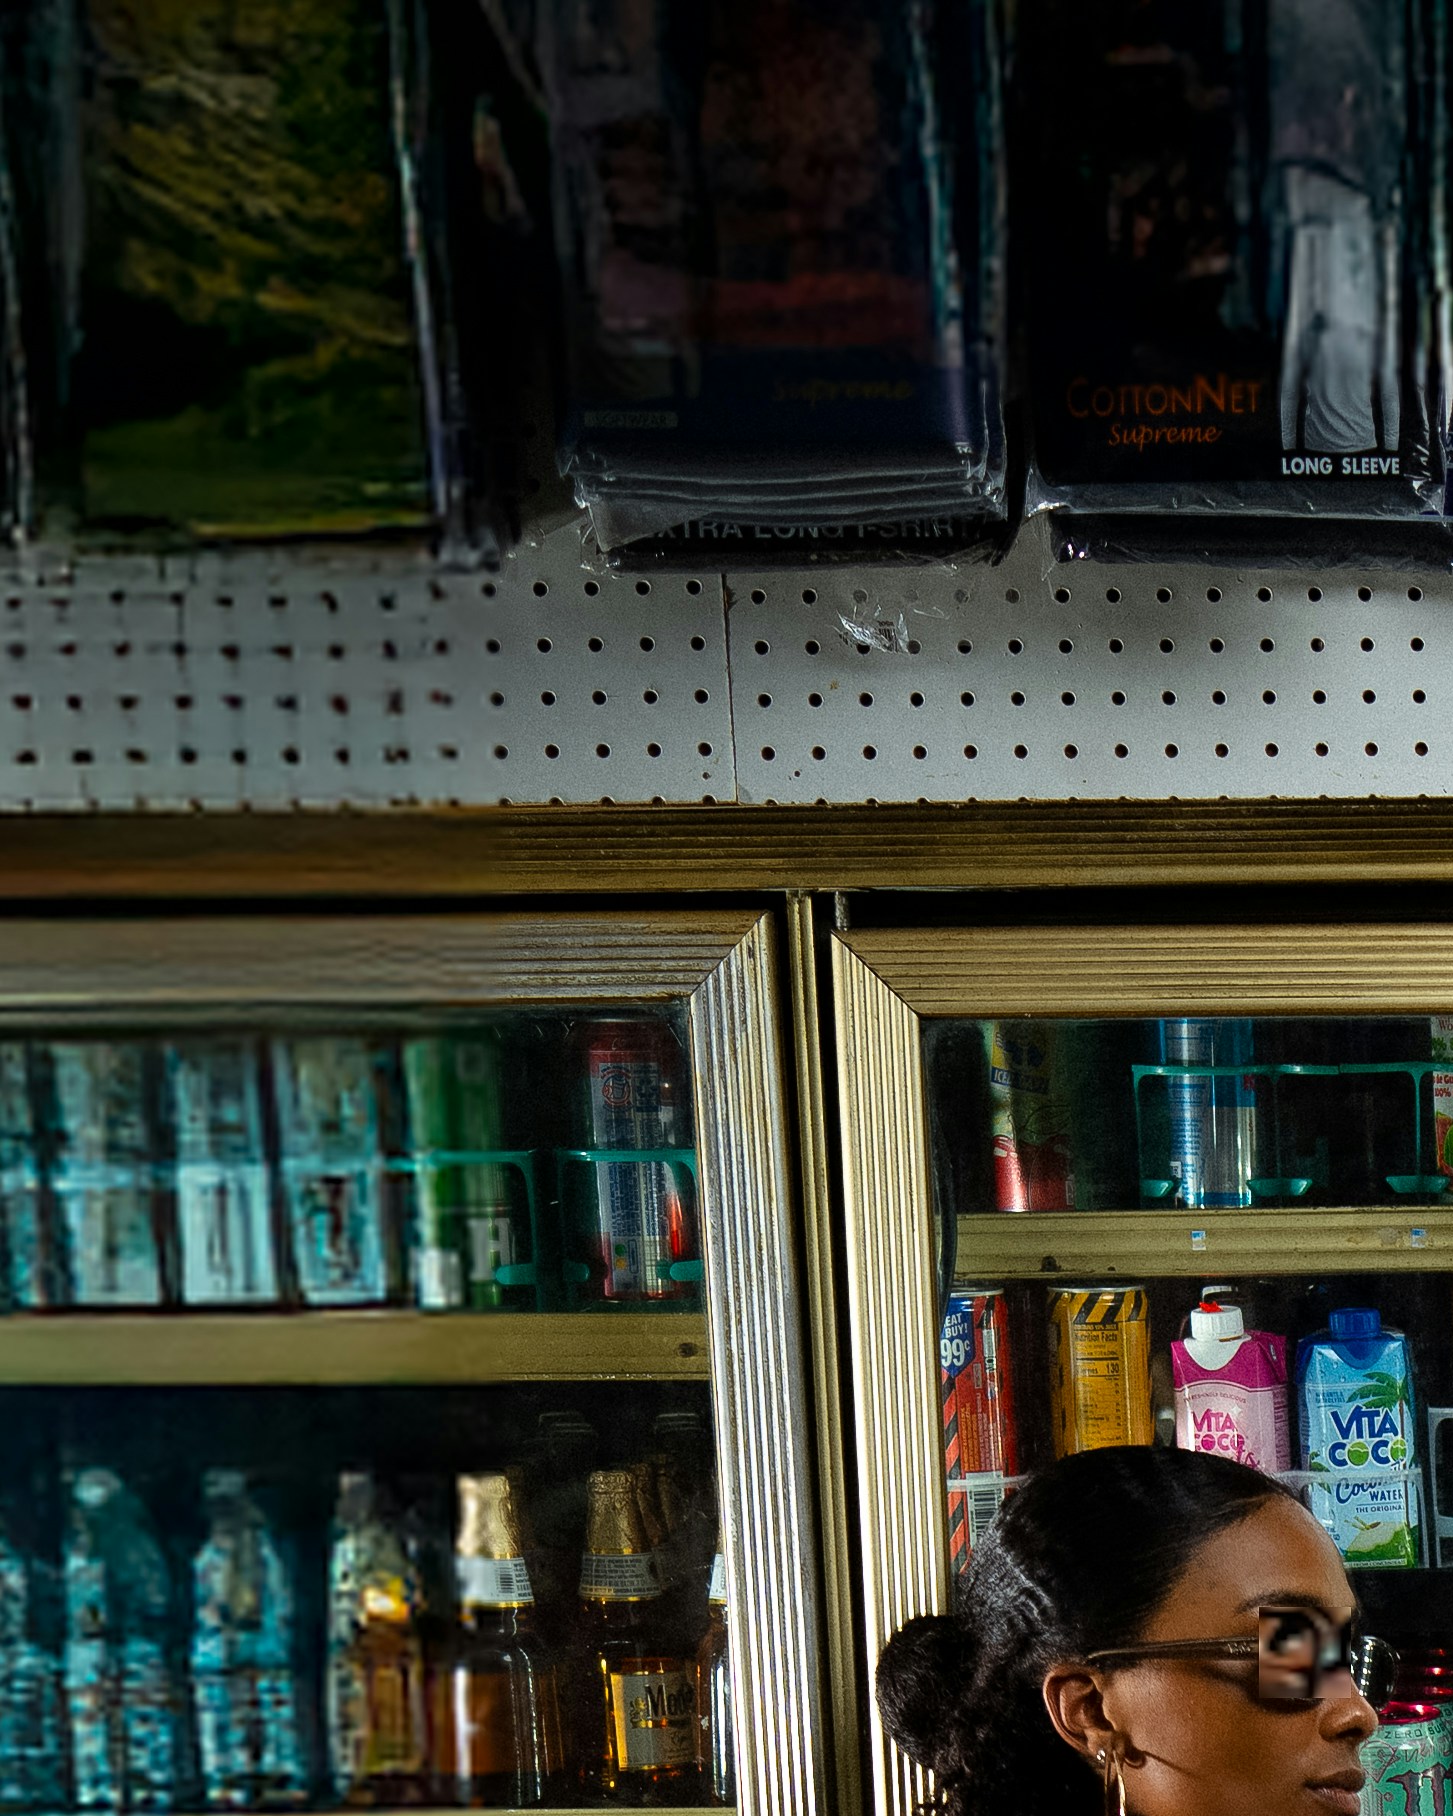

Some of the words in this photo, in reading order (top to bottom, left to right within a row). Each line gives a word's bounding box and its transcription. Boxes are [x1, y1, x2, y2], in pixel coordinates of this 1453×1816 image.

[1105, 422, 1224, 453] Supreme
[1281, 456, 1333, 476] LONG
[1342, 456, 1400, 476] SLEEVE
[945, 1324, 969, 1337] BUY!
[1191, 1409, 1238, 1434] VITA
[1329, 1405, 1400, 1441] VITA
[1327, 1438, 1408, 1468] COCO
[1369, 1488, 1405, 1502] WATER
[1355, 1504, 1373, 1514] THE
